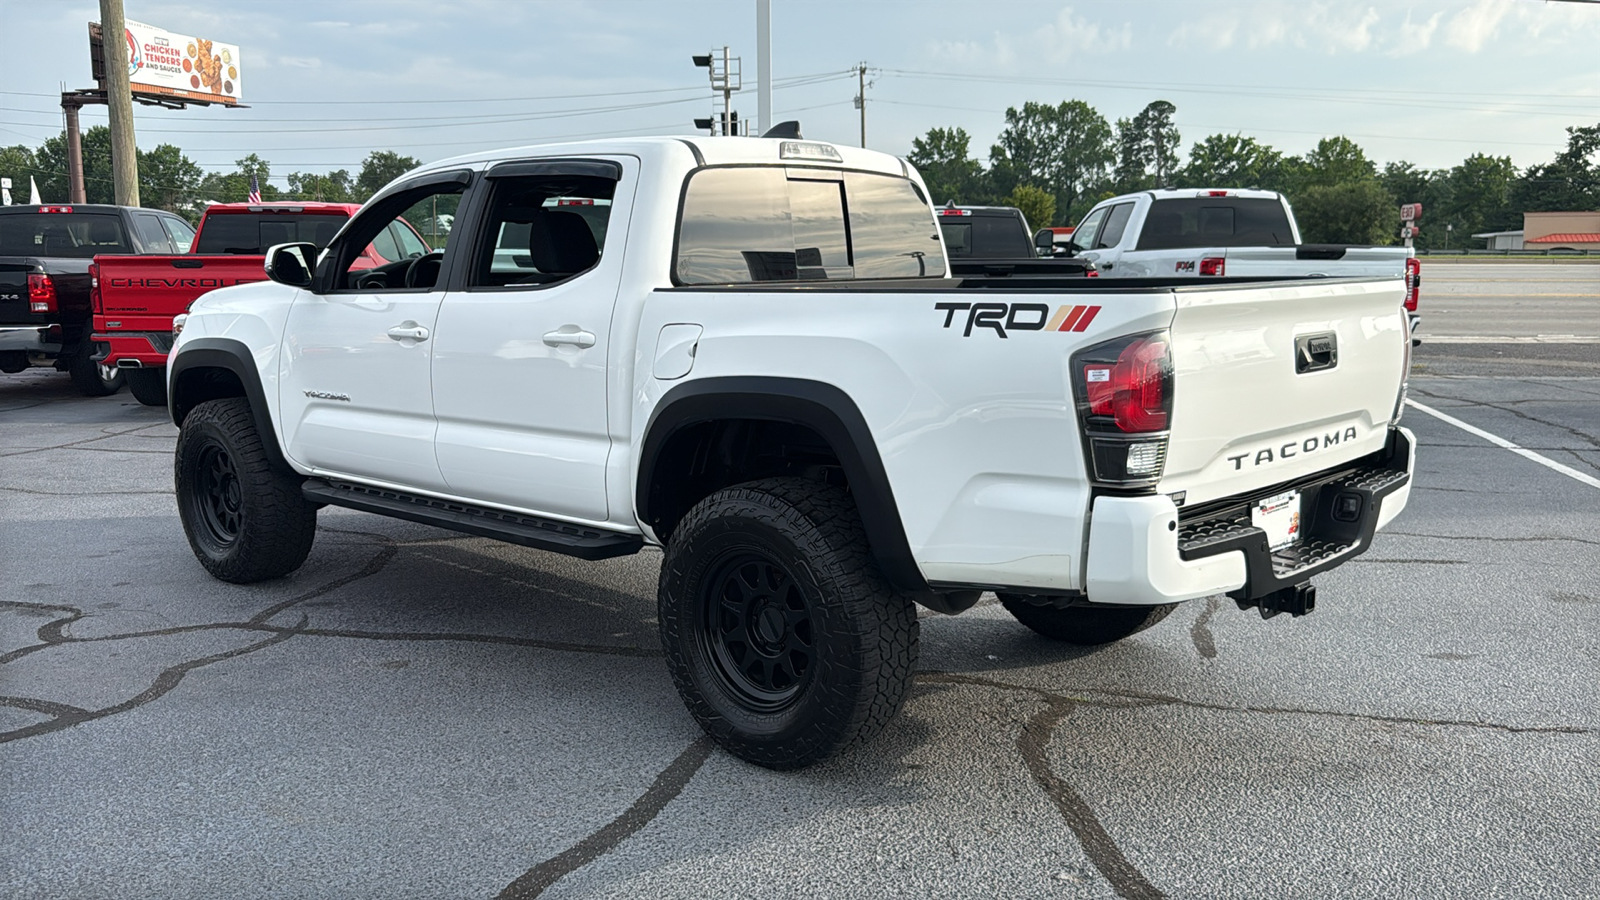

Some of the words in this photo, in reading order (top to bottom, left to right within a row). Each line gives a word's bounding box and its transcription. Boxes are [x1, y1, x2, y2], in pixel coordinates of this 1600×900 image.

[144, 44, 180, 57] CHICKEN
[144, 52, 181, 66] TENDERS
[146, 62, 158, 70] AND
[160, 65, 182, 74] SAUCES
[111, 278, 264, 288] CHEVROL
[934, 302, 1049, 338] TRD
[1227, 426, 1357, 470] TACOMA
